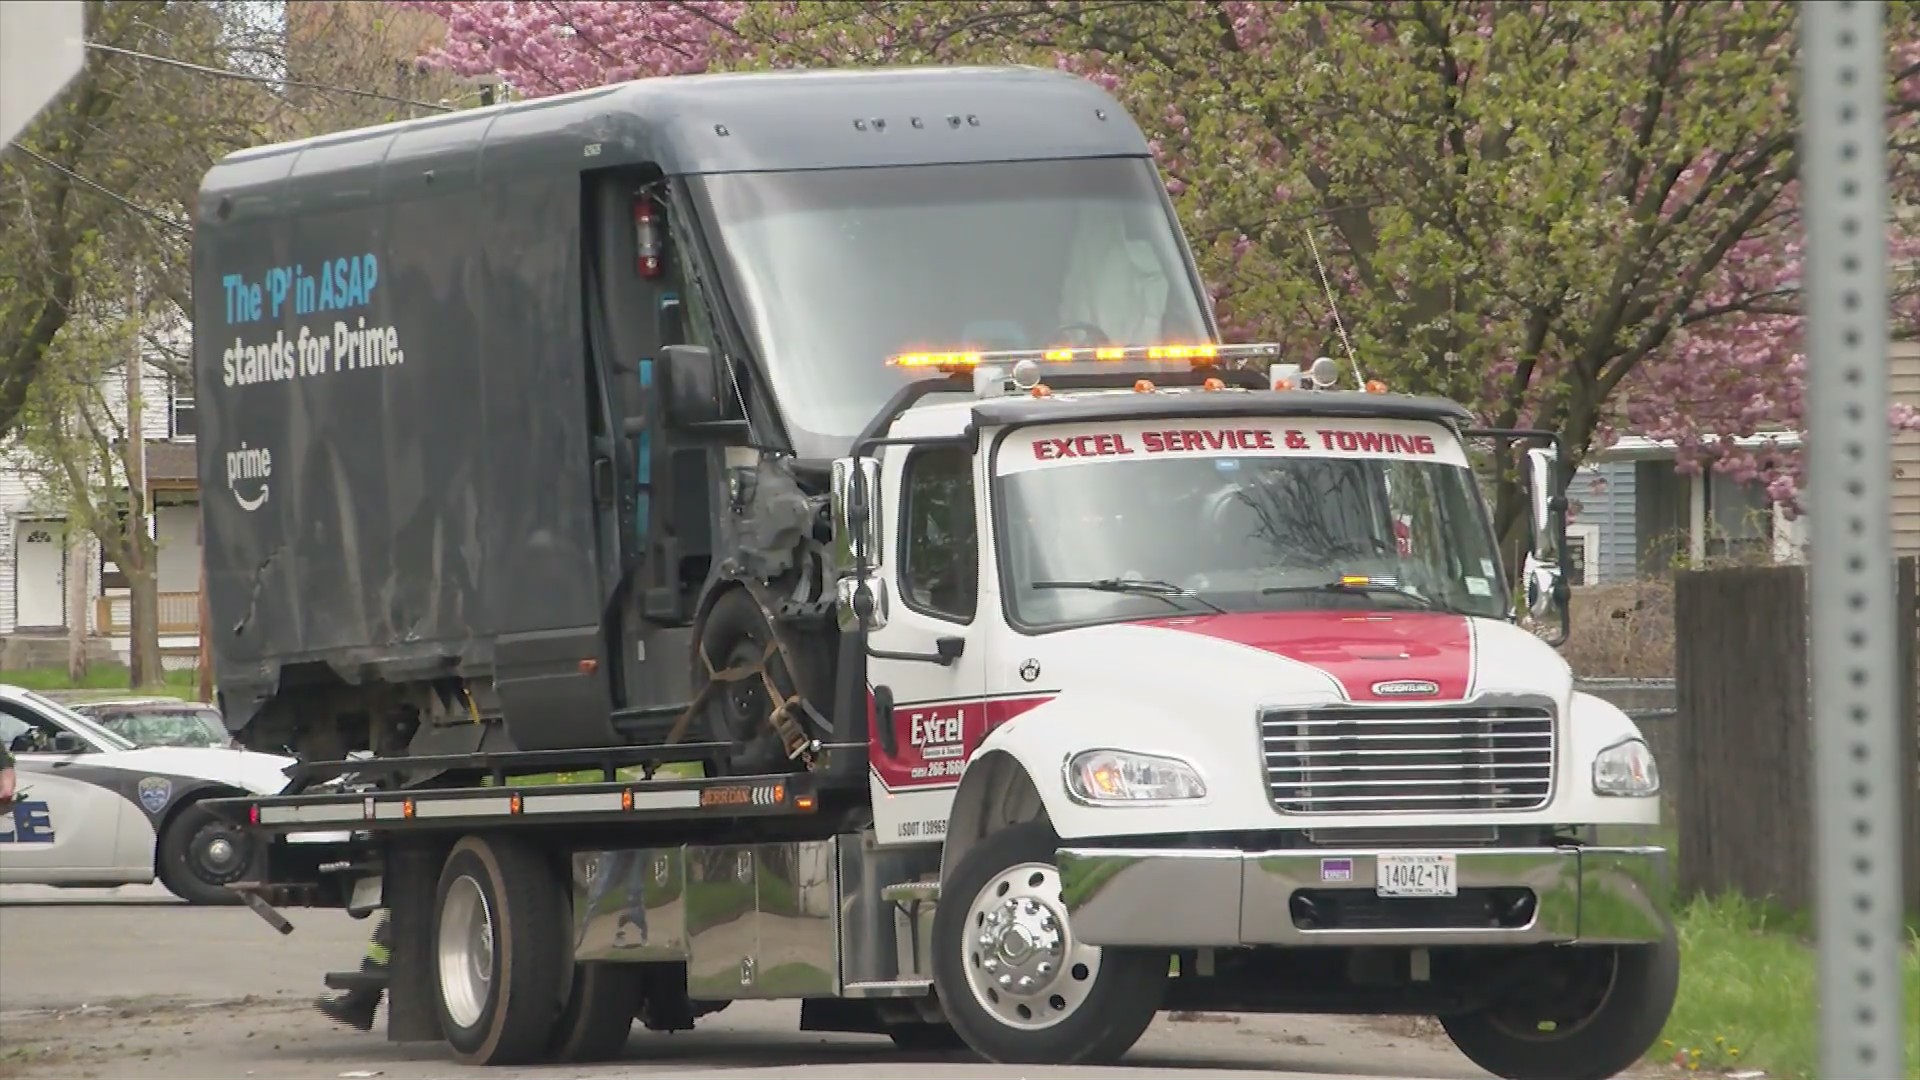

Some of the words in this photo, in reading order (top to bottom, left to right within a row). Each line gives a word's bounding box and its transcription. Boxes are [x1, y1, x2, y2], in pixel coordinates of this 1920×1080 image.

[223, 273, 262, 325] The
[296, 264, 315, 315] in
[319, 253, 378, 311] ASAP
[223, 330, 295, 388] stands
[298, 326, 331, 377] for
[334, 316, 404, 373] Prime.
[227, 441, 272, 489] prime
[1032, 434, 1134, 460] EXCEL
[1142, 430, 1275, 453] SERVICE
[1285, 430, 1310, 449] &
[1317, 430, 1435, 454] TOWING
[911, 709, 964, 745] Excel
